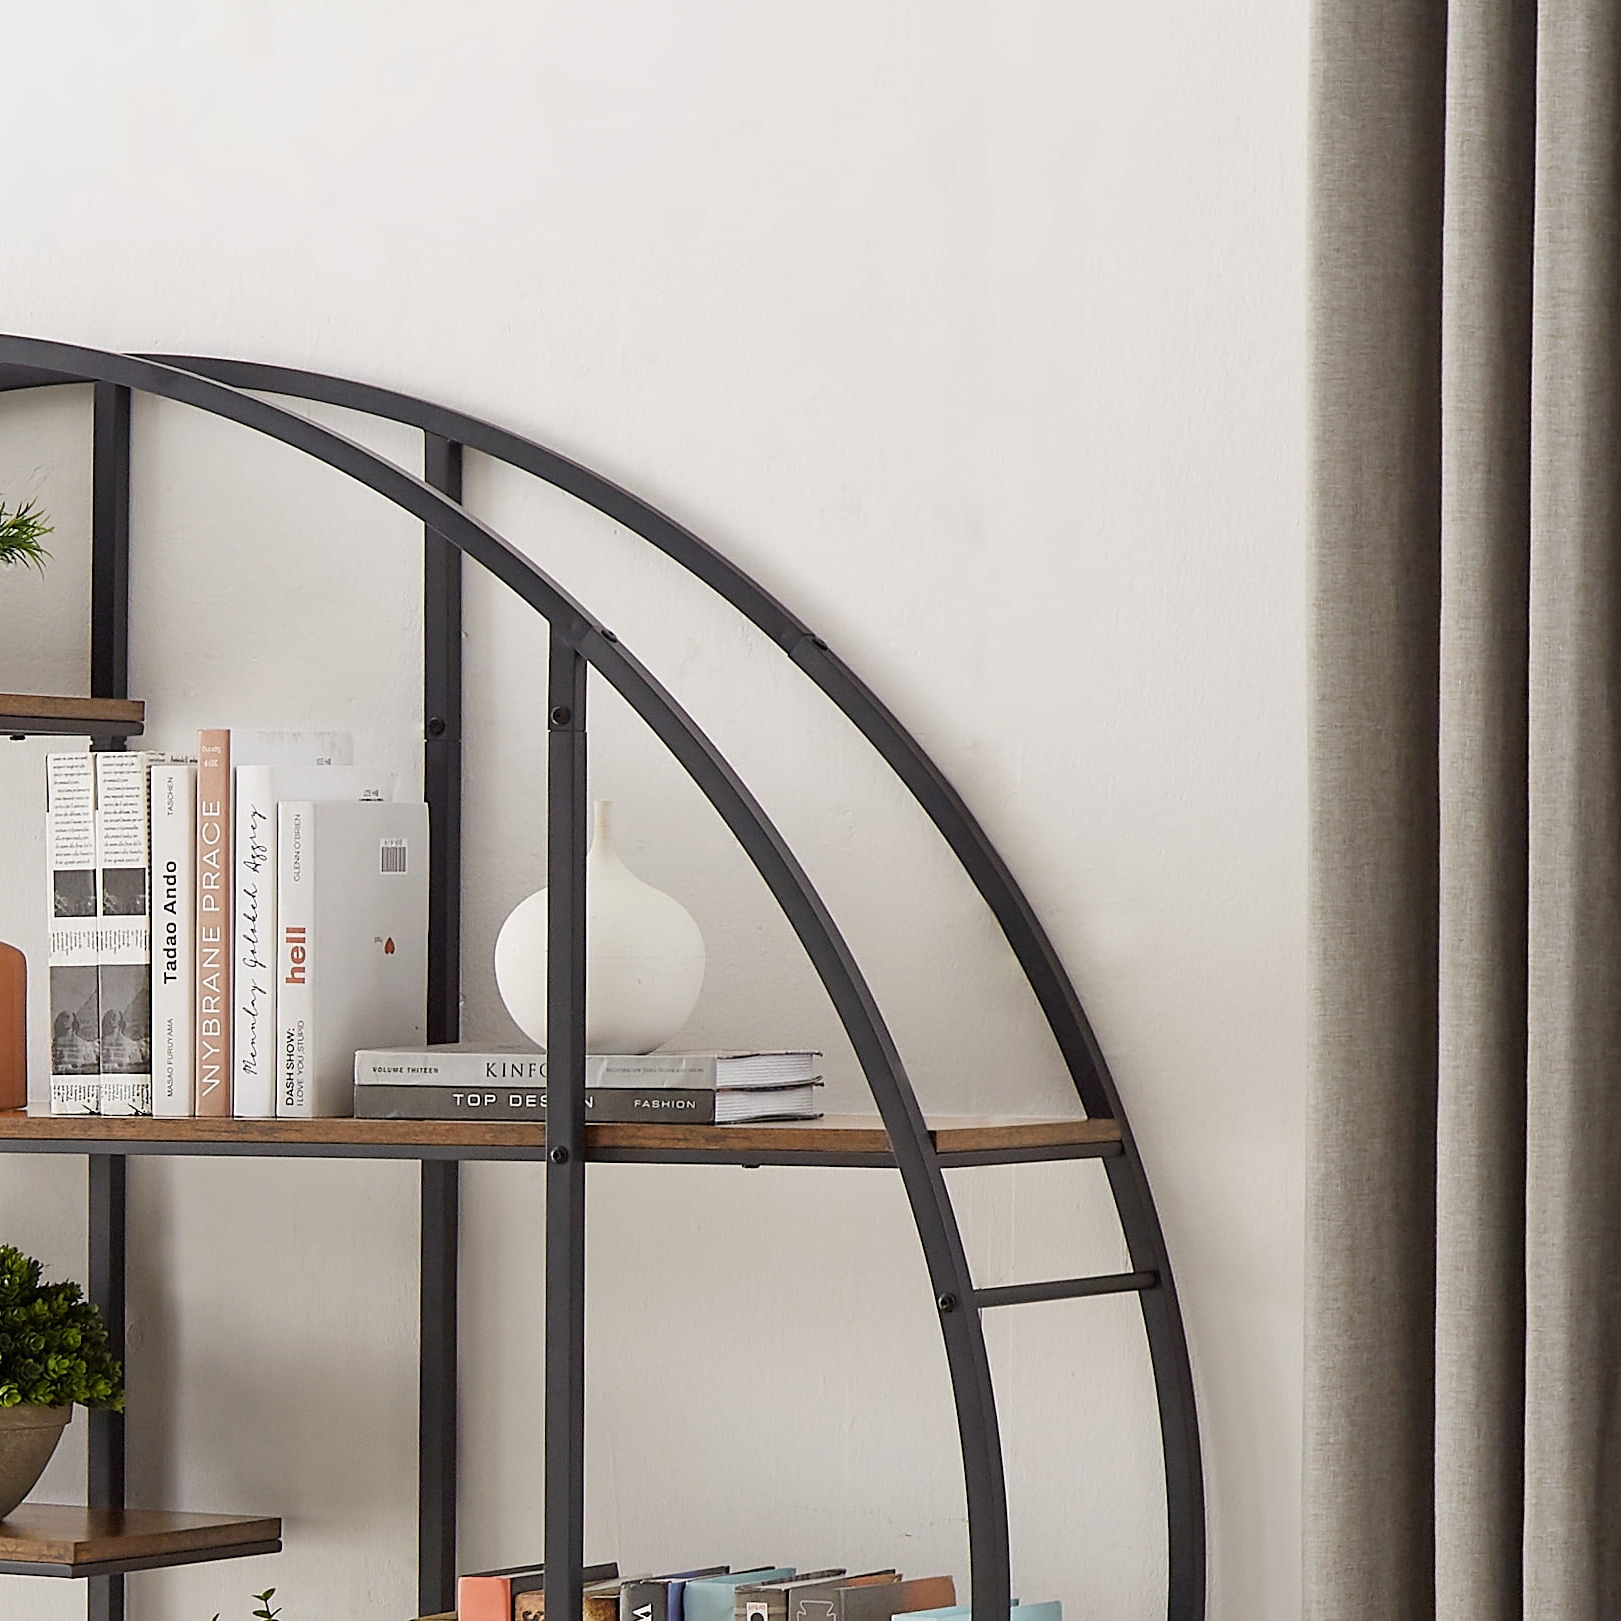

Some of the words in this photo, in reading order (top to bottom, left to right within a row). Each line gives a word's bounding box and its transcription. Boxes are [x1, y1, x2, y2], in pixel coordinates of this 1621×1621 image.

[167, 776, 175, 816] TASCHEN
[202, 800, 221, 912] PRACE
[243, 803, 267, 875] Aggrey
[163, 861, 178, 915] Ando
[163, 922, 178, 985] Tadao
[285, 927, 306, 984] hell
[202, 926, 221, 1097] WYBRANE
[285, 1028, 295, 1070] SHOW:
[285, 1073, 295, 1106] DASH
[452, 1093, 497, 1108] TOP
[509, 1093, 594, 1109] DESN
[633, 1098, 696, 1110] FASHION
